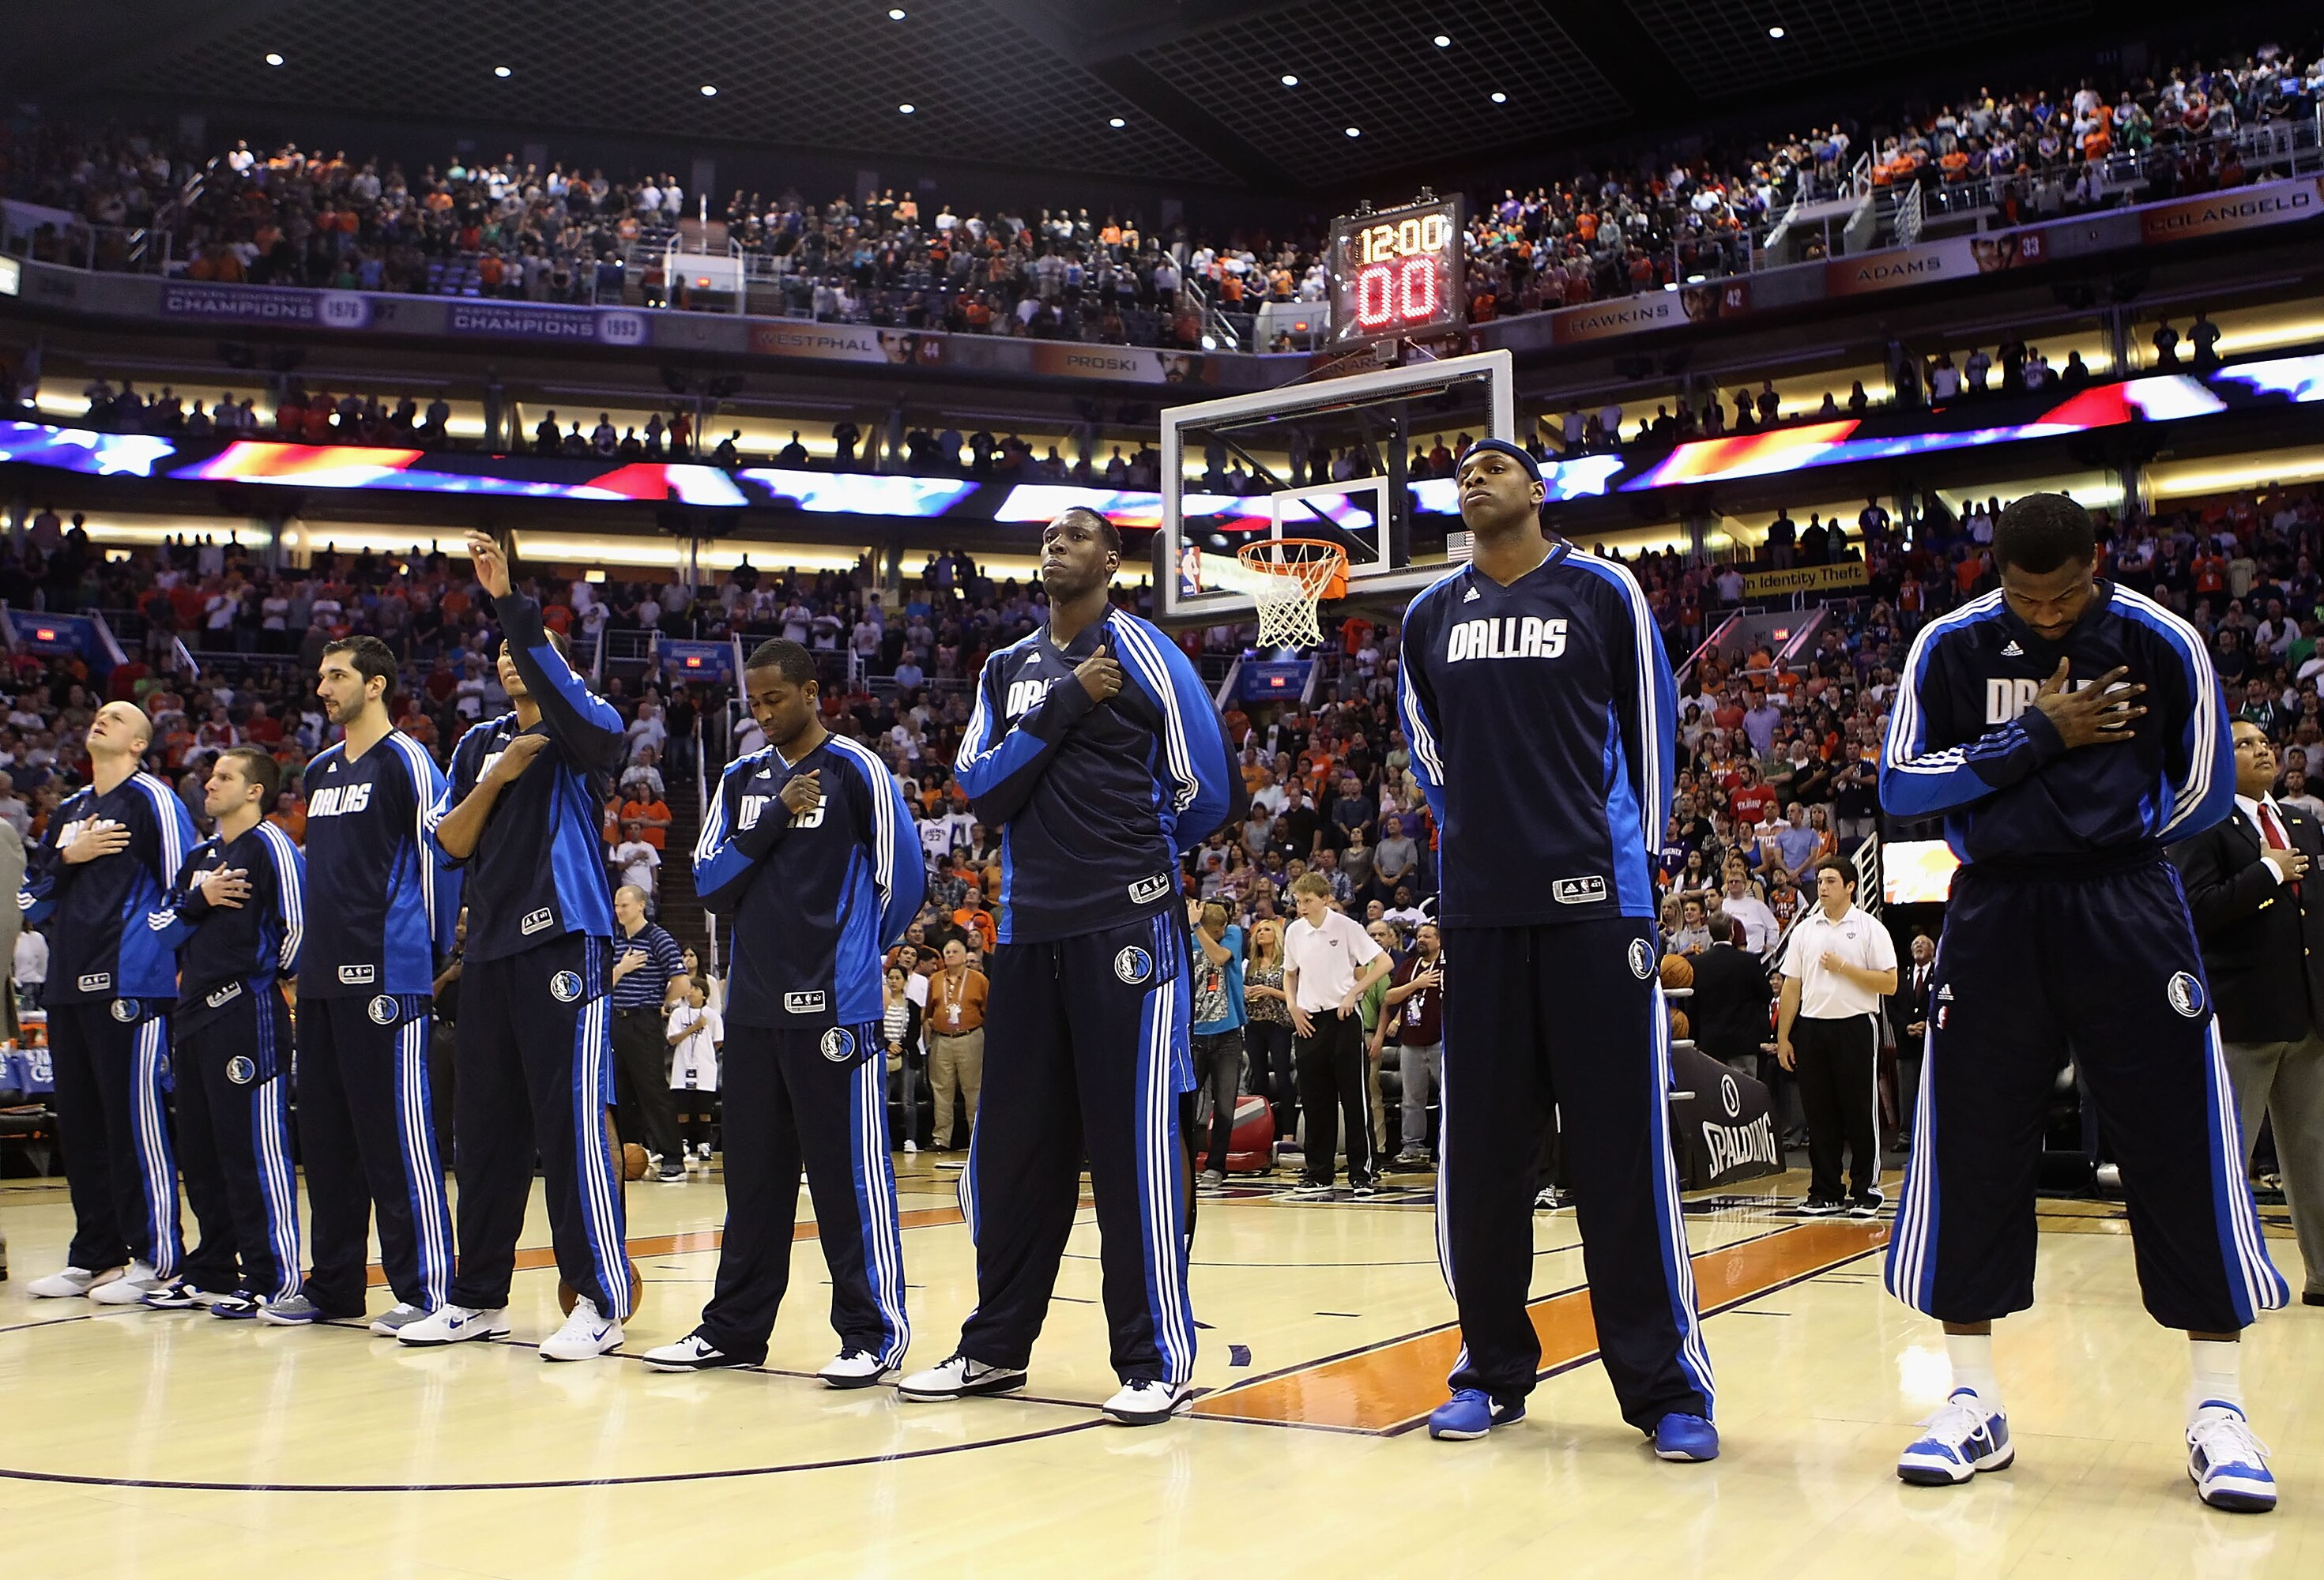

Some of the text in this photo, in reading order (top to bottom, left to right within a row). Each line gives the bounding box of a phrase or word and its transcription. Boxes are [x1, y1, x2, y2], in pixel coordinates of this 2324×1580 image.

[2149, 192, 2309, 231] COLANGELO
[1360, 214, 1444, 265] 12:00
[1858, 236, 2040, 281] ADAMS 33
[167, 296, 314, 318] CHAMPIONS
[1359, 258, 1435, 325] 00
[454, 315, 593, 337] CHAMPIONS
[1570, 289, 1741, 333] HAWKINS 42
[759, 331, 939, 358] WESTPHAL 44
[1067, 356, 1137, 371] PROSKI
[1760, 570, 1816, 588] Identity
[1821, 566, 1862, 581] Theft
[1447, 616, 1568, 663] DALLAS
[307, 783, 372, 818] DALLAS
[1667, 855, 1671, 866] 1
[1702, 1112, 1777, 1179] SPALDING
